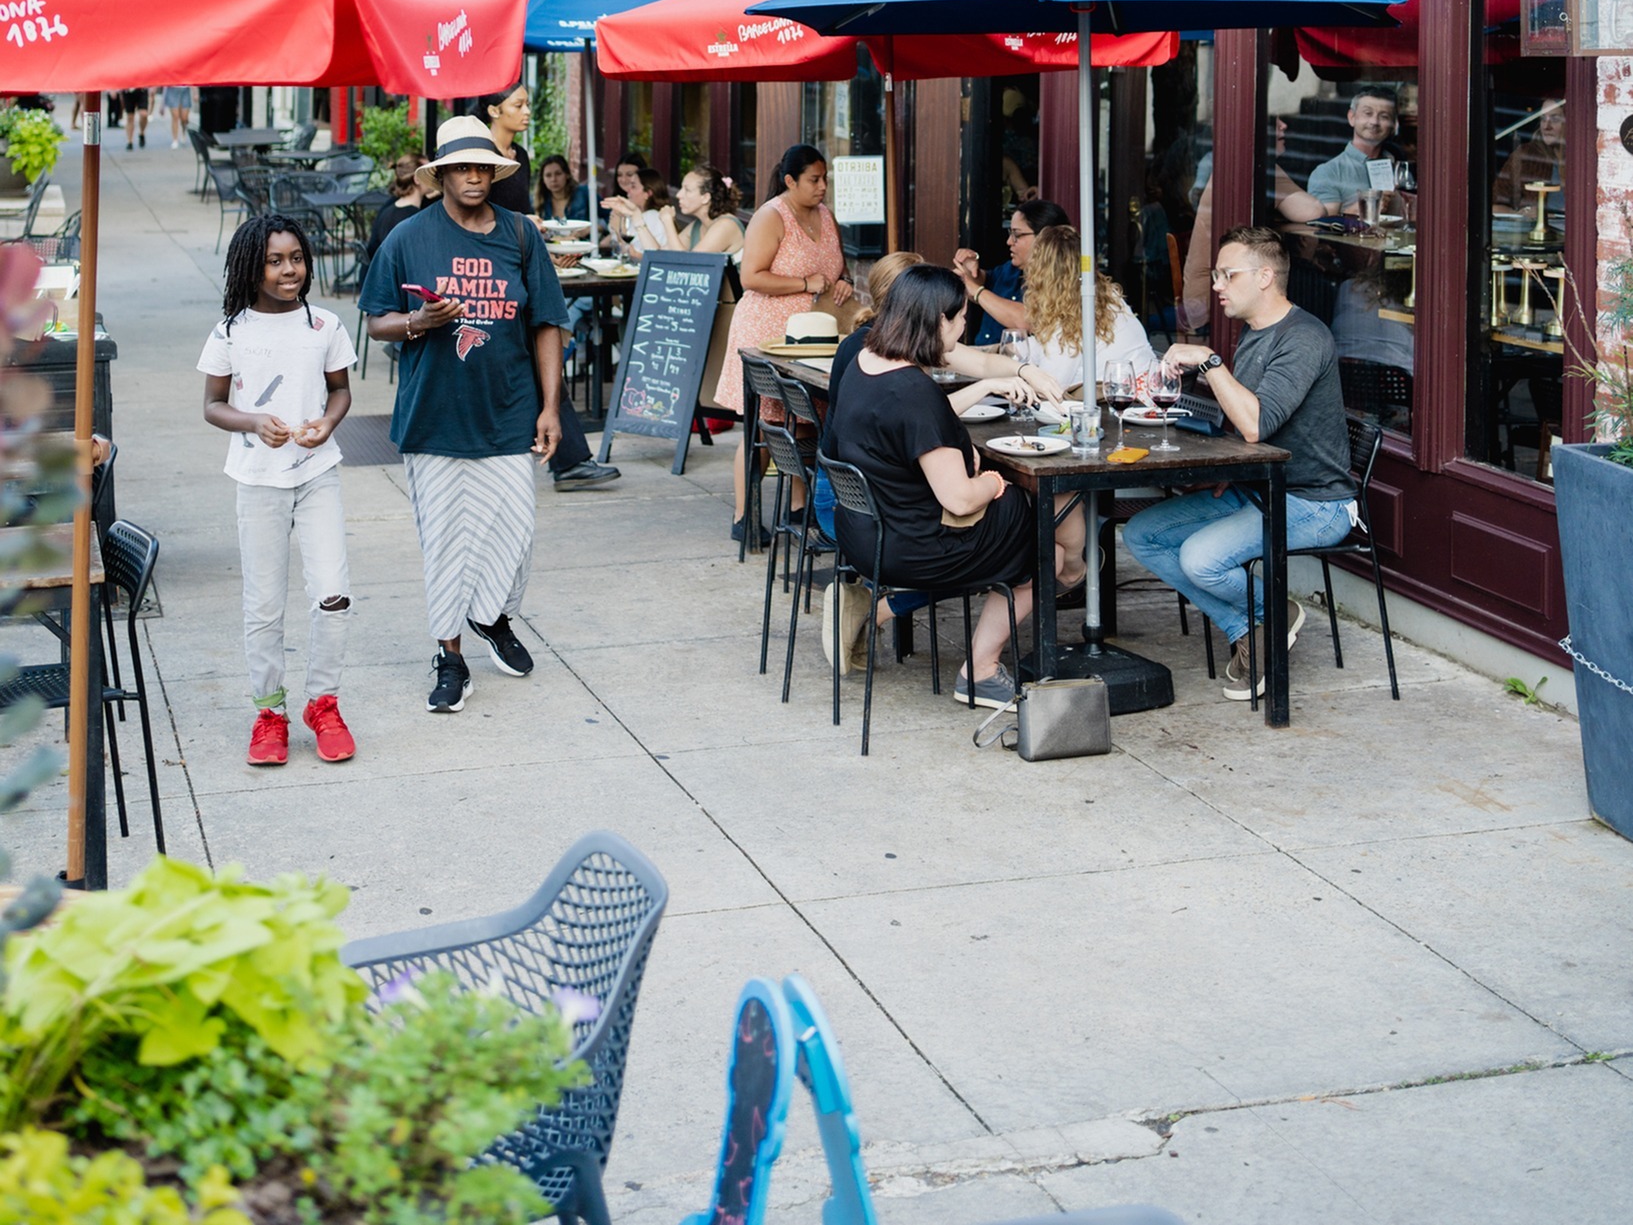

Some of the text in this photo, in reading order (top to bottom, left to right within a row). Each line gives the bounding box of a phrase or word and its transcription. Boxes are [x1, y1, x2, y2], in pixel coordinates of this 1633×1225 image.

[452, 257, 493, 277] GOD
[435, 276, 508, 299] FAMILY
[452, 297, 518, 320] CONS
